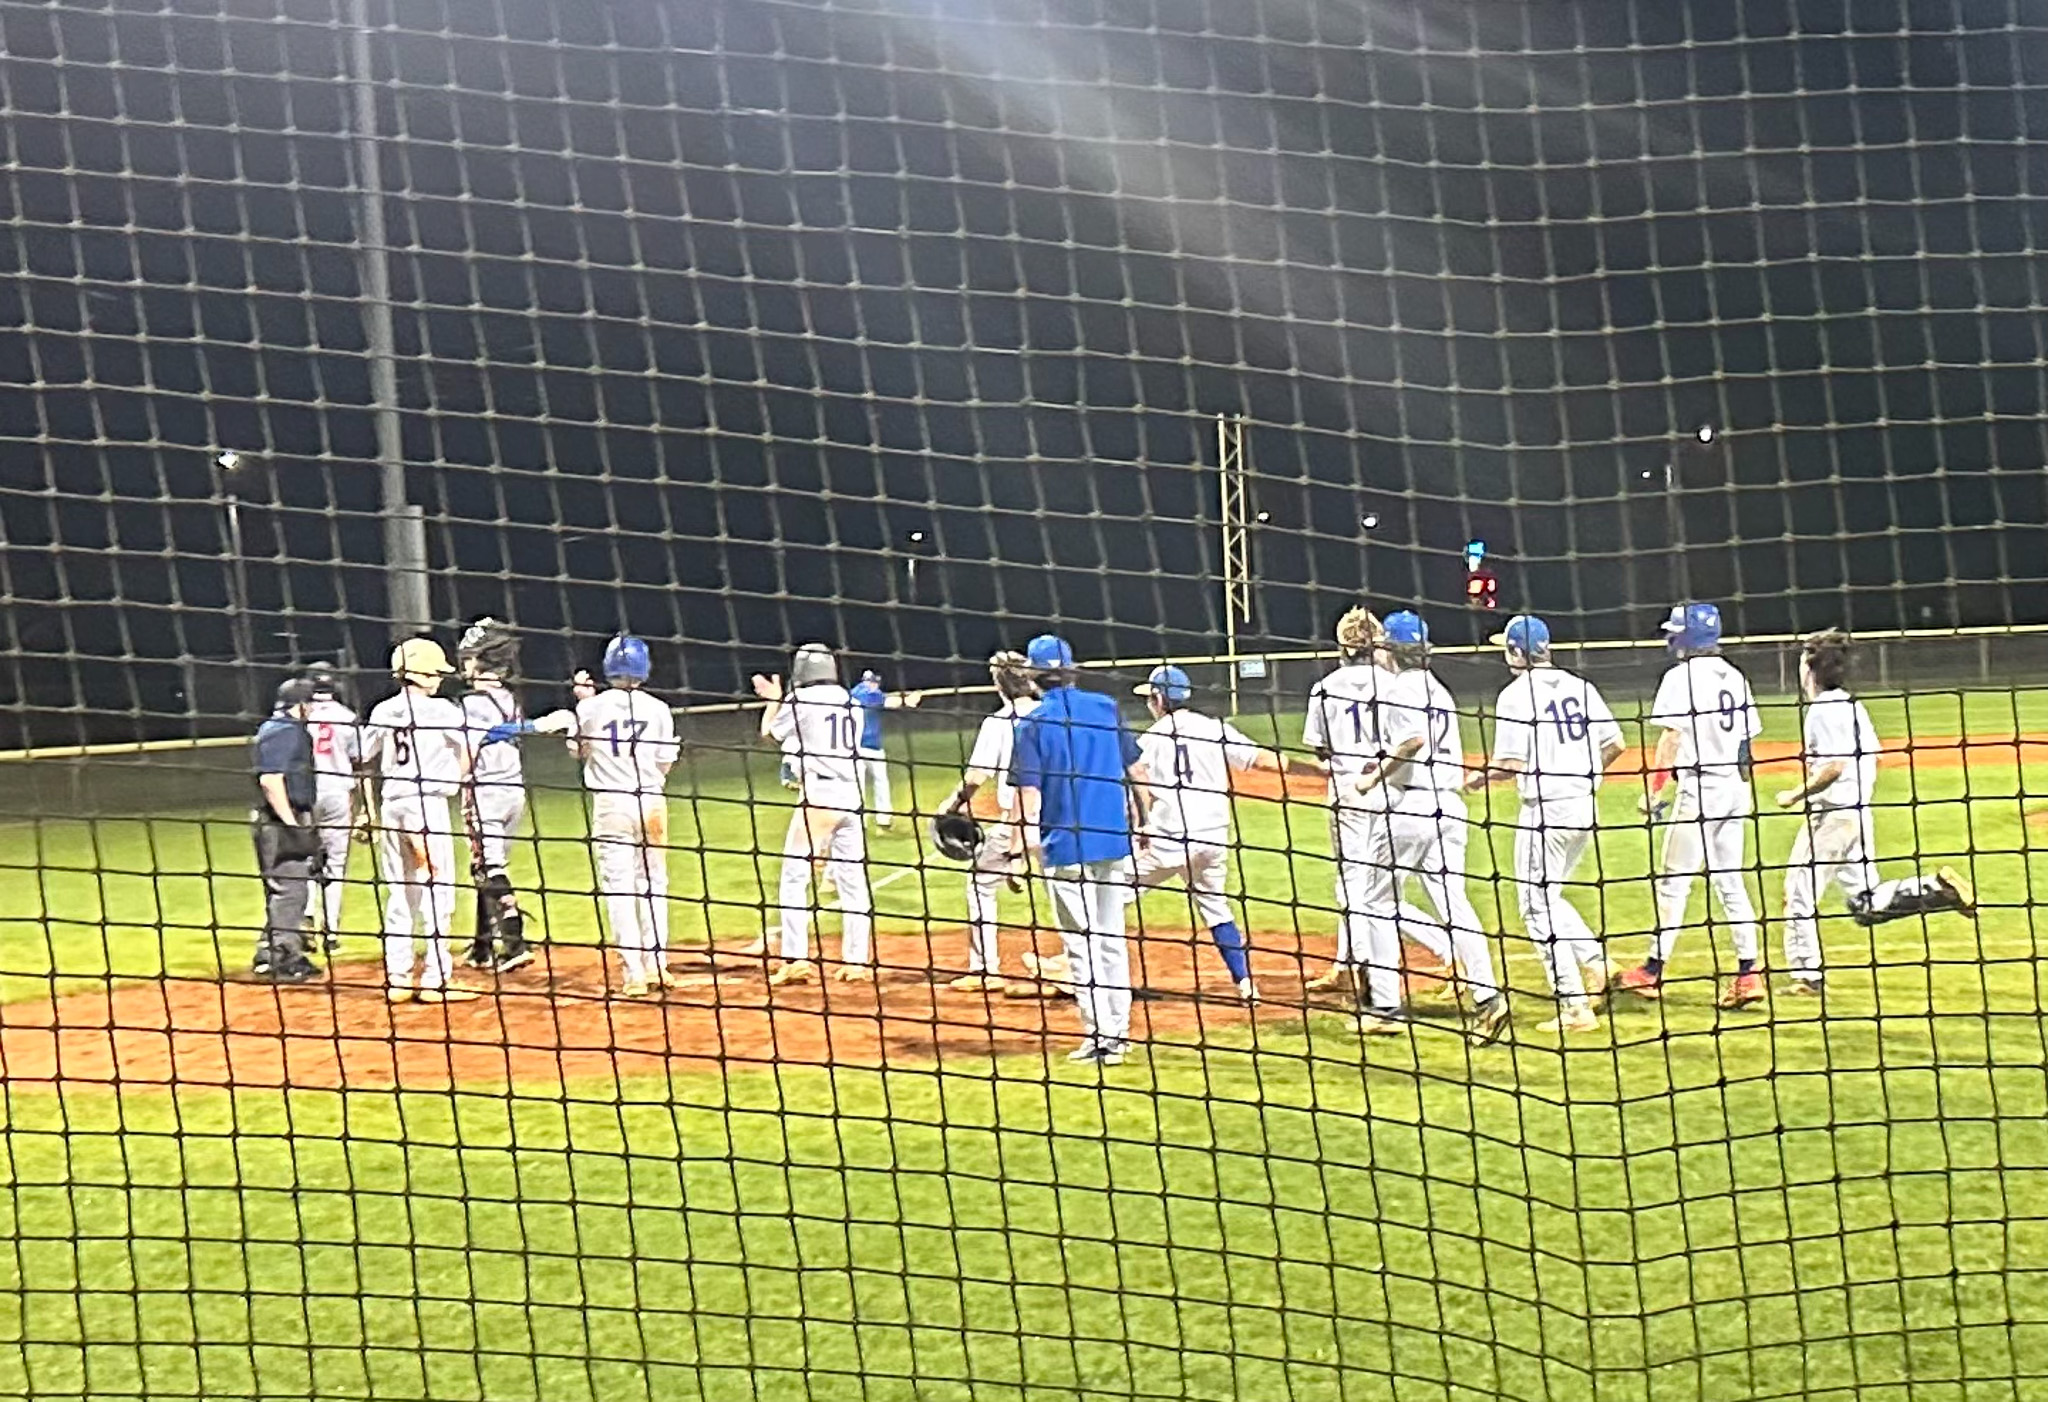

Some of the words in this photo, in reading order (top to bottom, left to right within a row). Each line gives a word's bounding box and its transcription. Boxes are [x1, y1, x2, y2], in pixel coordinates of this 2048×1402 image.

[1544, 696, 1587, 744] 16
[1718, 689, 1735, 732] 9
[316, 723, 334, 754] 2
[393, 727, 410, 766] 6
[602, 719, 649, 757] 17
[825, 712, 857, 750] 10
